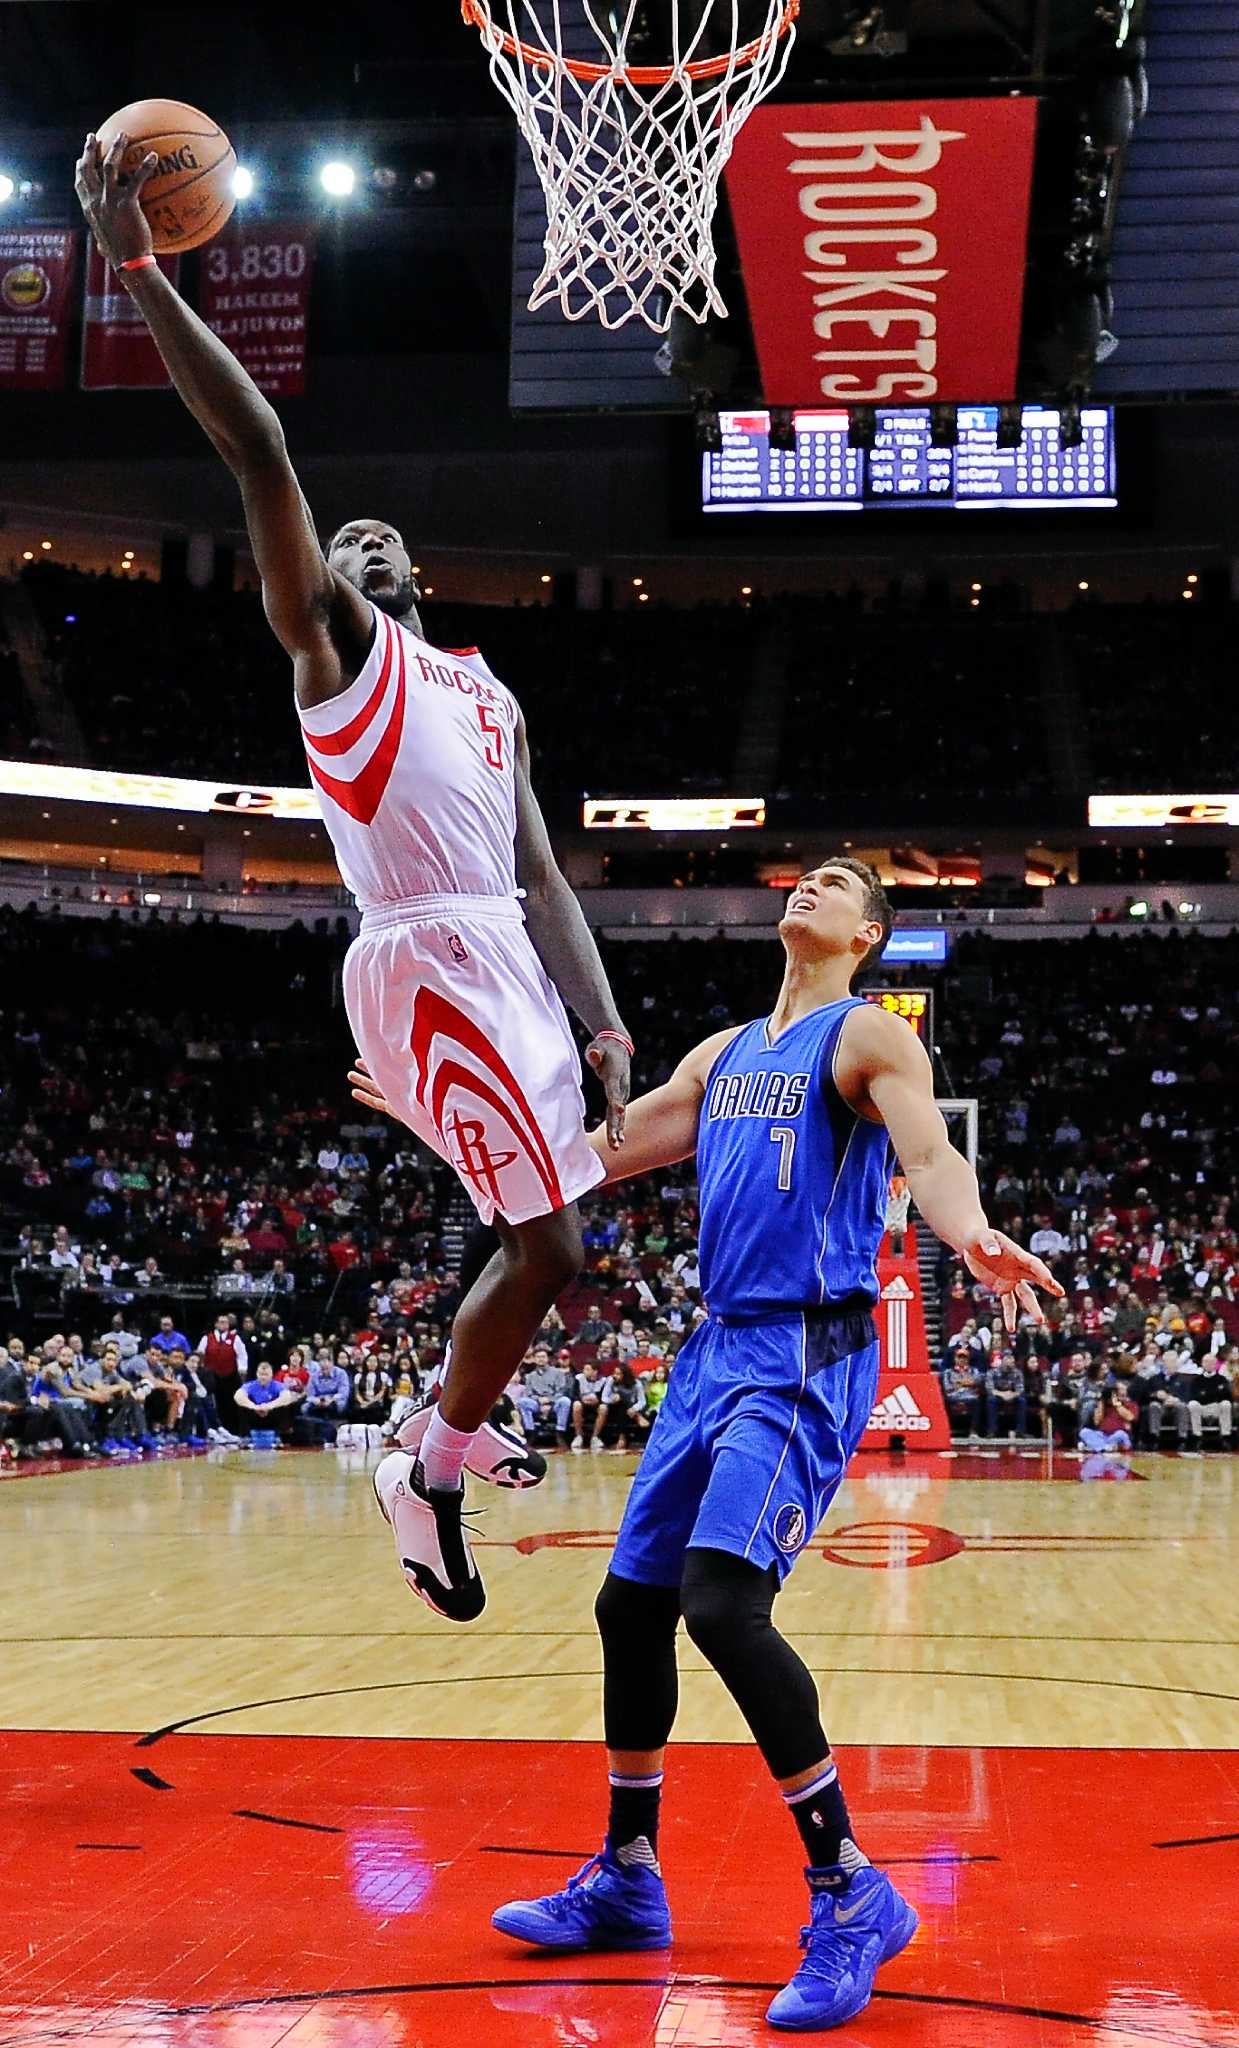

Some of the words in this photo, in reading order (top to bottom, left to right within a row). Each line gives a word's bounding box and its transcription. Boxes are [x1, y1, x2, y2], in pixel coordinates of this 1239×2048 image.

[208, 243, 305, 286] 3,830
[782, 116, 967, 400] ROCKETS
[476, 704, 503, 770] 5
[708, 1071, 811, 1122] DALLAS
[770, 1127, 796, 1191] 7
[866, 1414, 930, 1431] adidas
